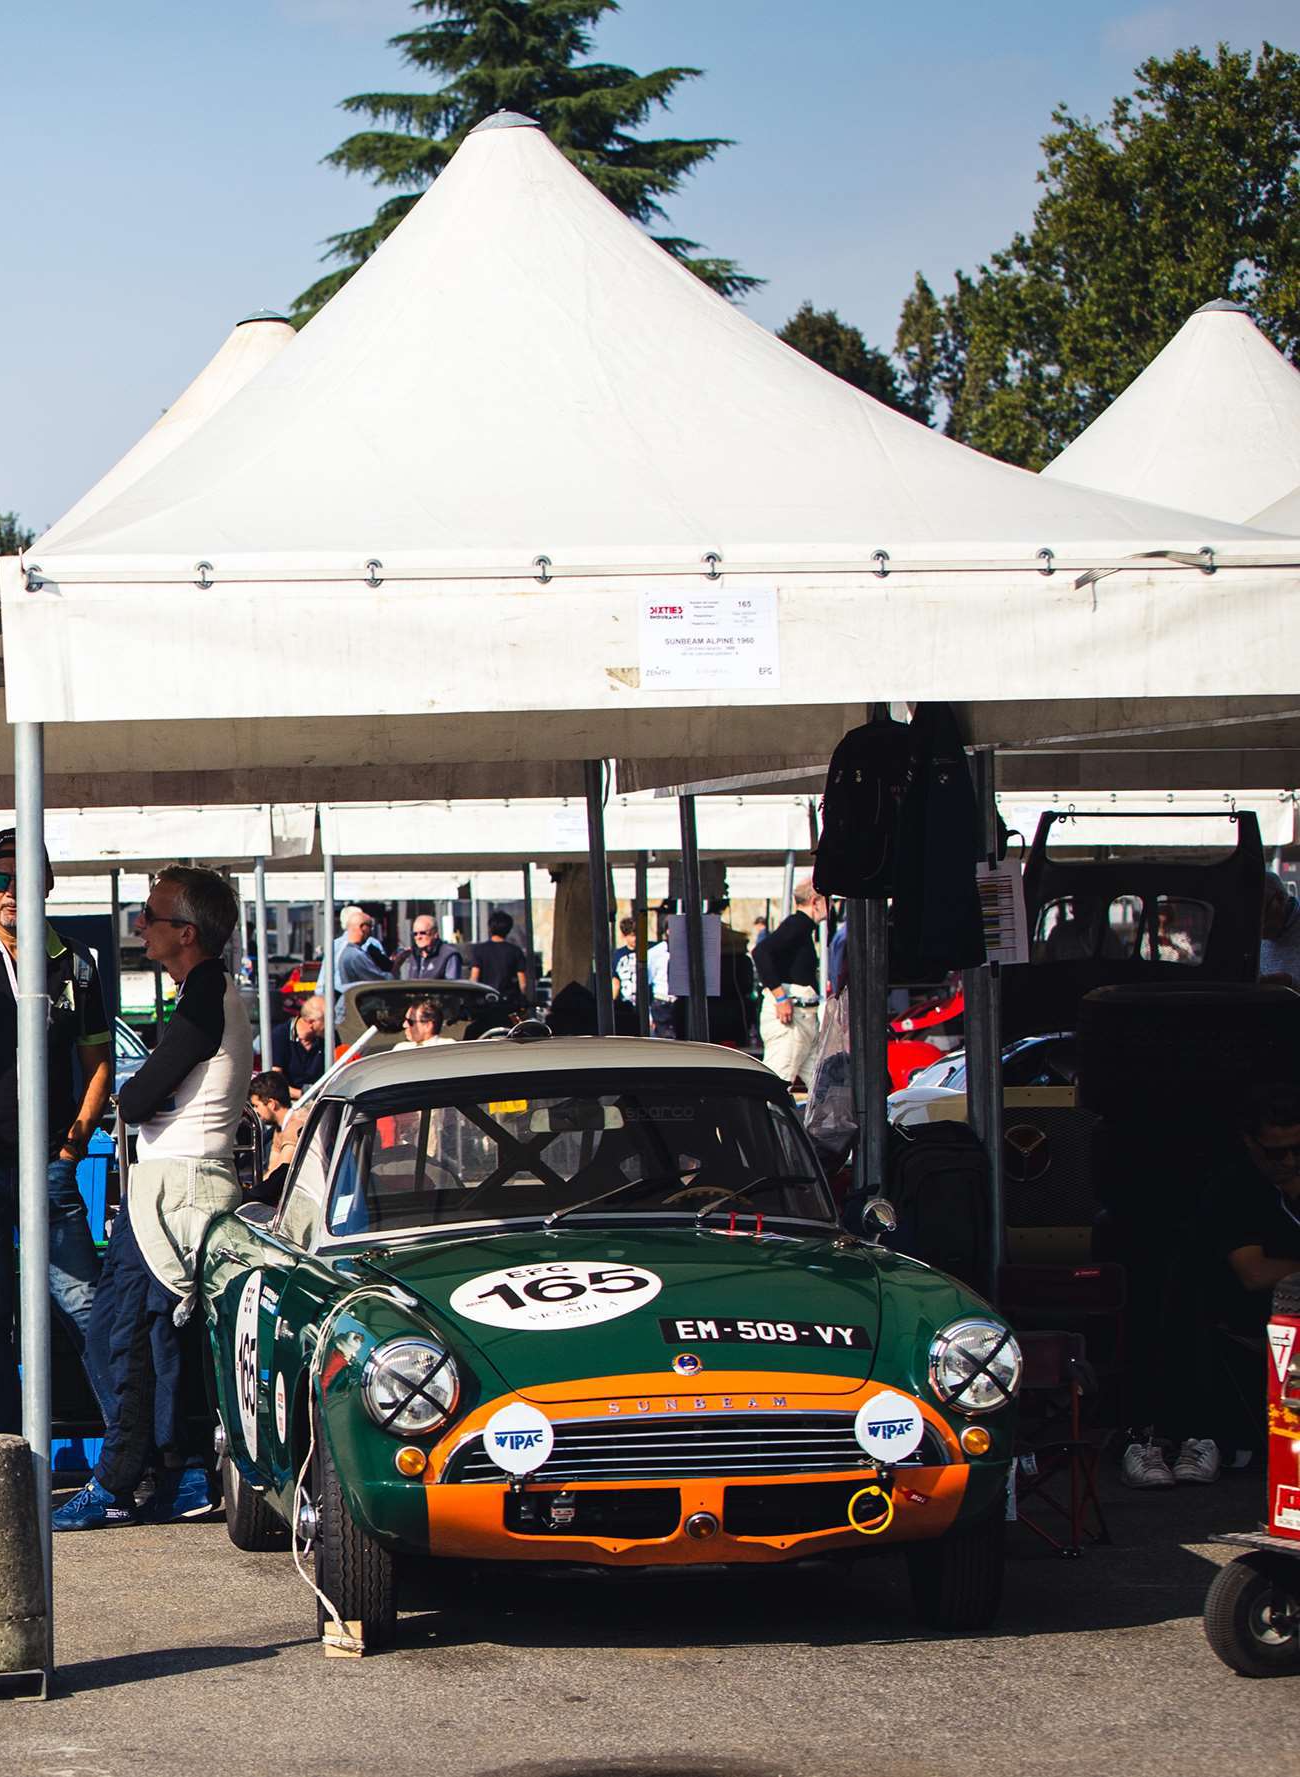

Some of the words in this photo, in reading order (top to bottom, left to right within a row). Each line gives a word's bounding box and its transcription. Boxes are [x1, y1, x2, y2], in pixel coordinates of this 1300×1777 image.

[649, 606, 684, 615] SIXTIES
[664, 638, 704, 646] SUNBEAM
[706, 637, 735, 645] ALPINE
[506, 1264, 570, 1279] EFG
[477, 1267, 650, 1311] 165
[238, 1332, 256, 1417] 165
[608, 1396, 787, 1413] SUNBEAM
[868, 1422, 913, 1440] WIPAC
[495, 1434, 543, 1450] WIPAC
